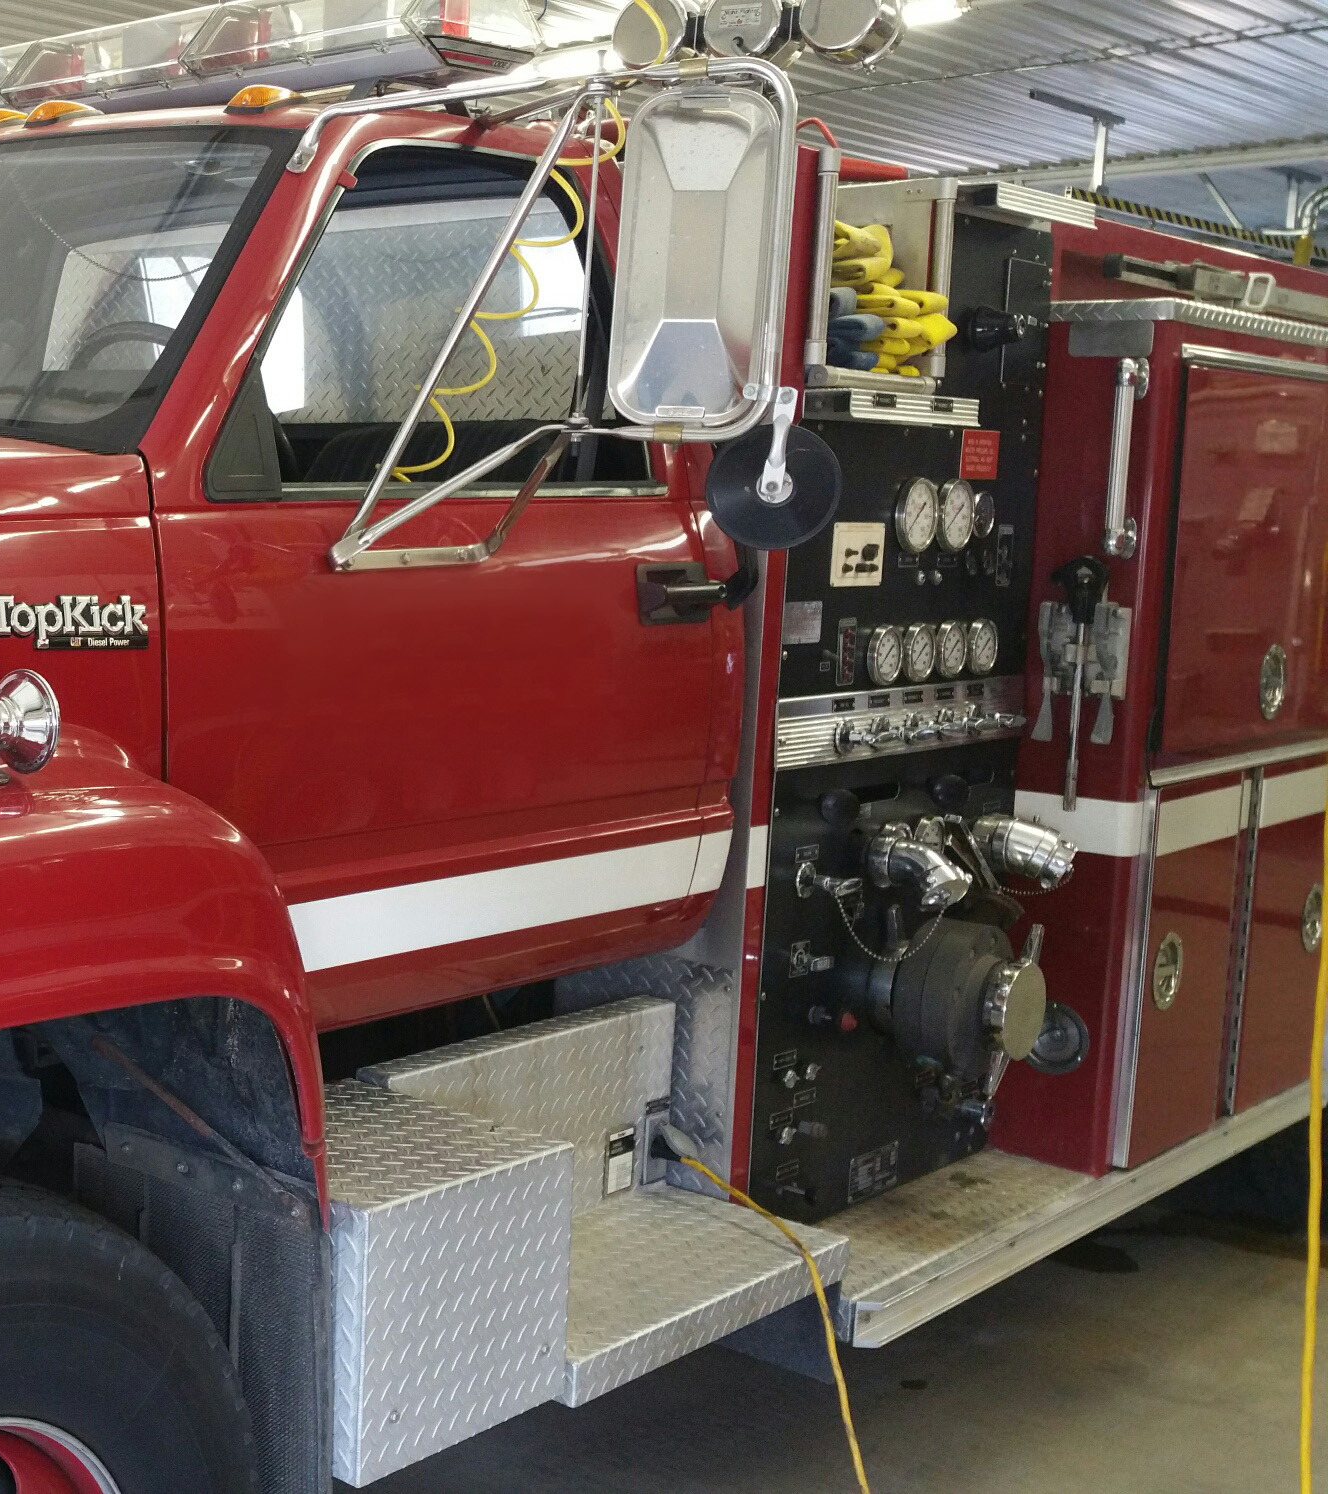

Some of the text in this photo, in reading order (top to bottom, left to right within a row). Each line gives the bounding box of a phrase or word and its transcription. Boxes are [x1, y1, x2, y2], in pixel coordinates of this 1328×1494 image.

[70, 637, 130, 647] CAT Diesel Power
